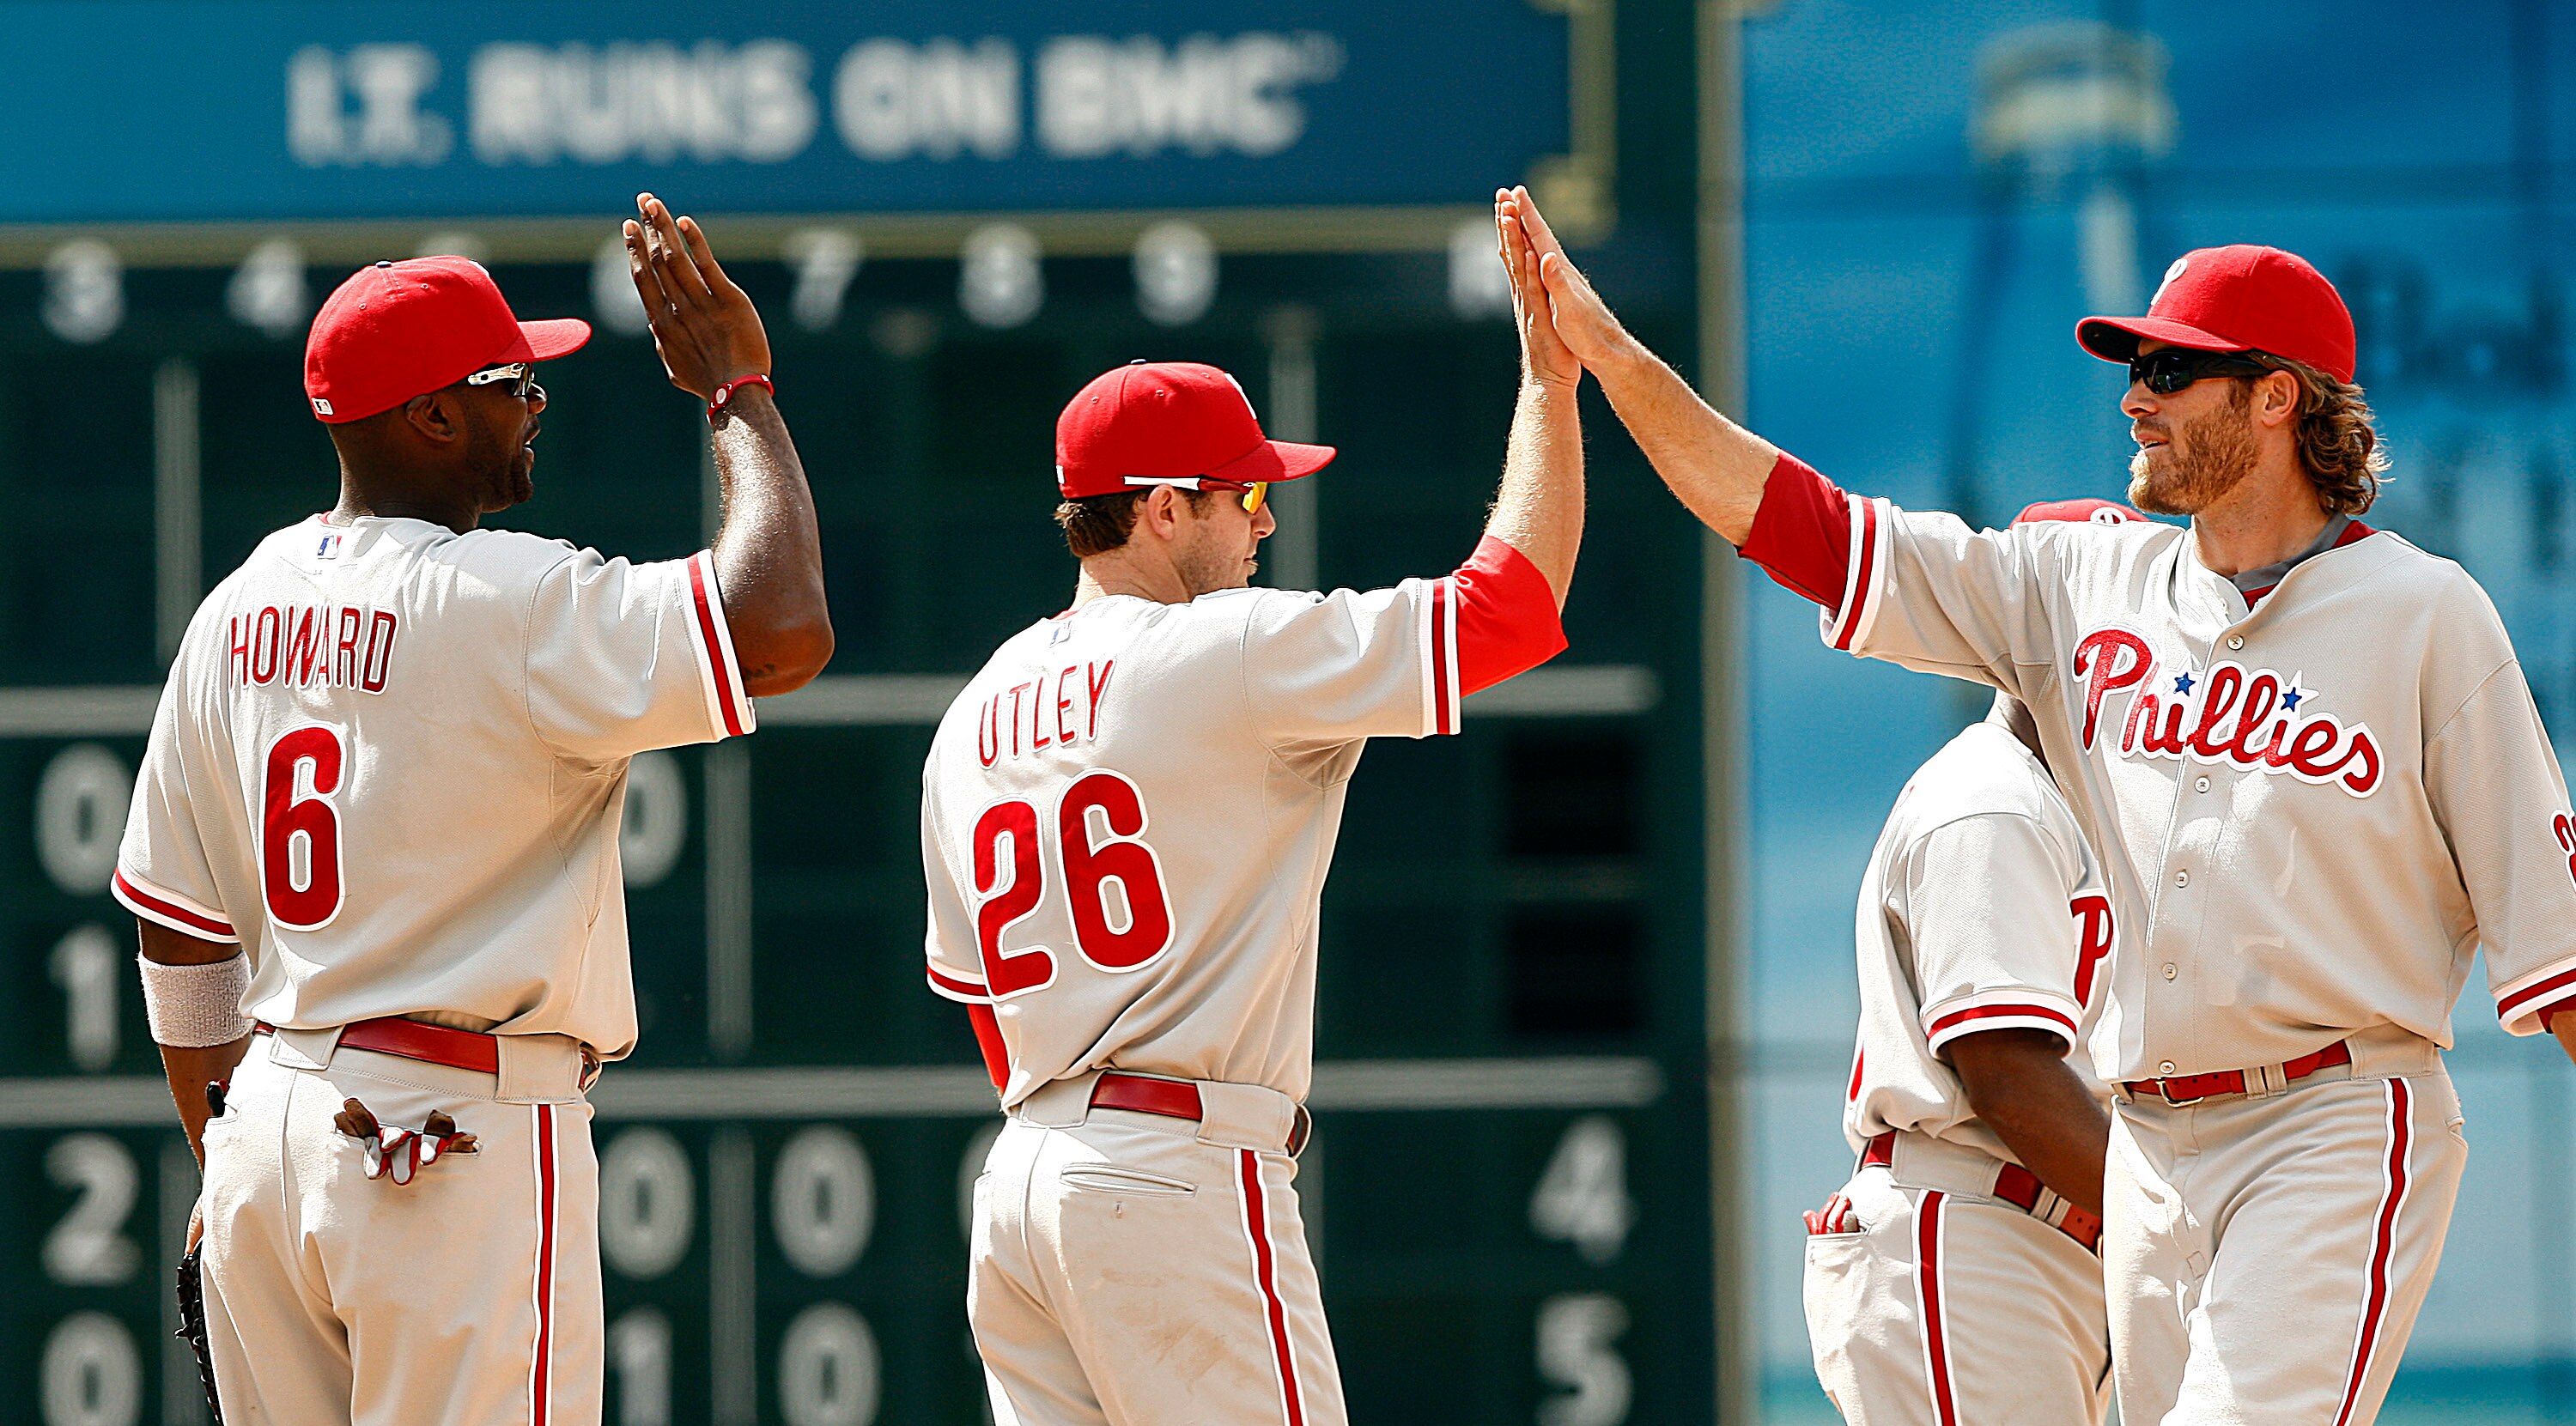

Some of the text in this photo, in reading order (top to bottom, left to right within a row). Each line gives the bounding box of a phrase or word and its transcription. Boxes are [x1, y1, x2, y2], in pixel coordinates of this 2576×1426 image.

[469, 39, 816, 162] RUNS
[835, 36, 1019, 160] ON
[46, 236, 124, 341] 3
[227, 236, 307, 338] 4
[785, 228, 861, 329] 7
[960, 223, 1042, 327] 8
[1133, 221, 1218, 325] 9
[228, 604, 399, 695] HOWARD
[979, 658, 1115, 768] UTLEY
[2073, 629, 2384, 798] Phillies
[38, 743, 131, 895] 0
[258, 723, 347, 931] 6
[970, 770, 1176, 1003] 26
[53, 926, 118, 1069] 1
[44, 1134, 139, 1284] 2
[600, 1128, 693, 1279] 0
[772, 1128, 874, 1275] 0
[1533, 1119, 1628, 1256] 4
[780, 1303, 879, 1426] 0
[1537, 1295, 1631, 1426] 5
